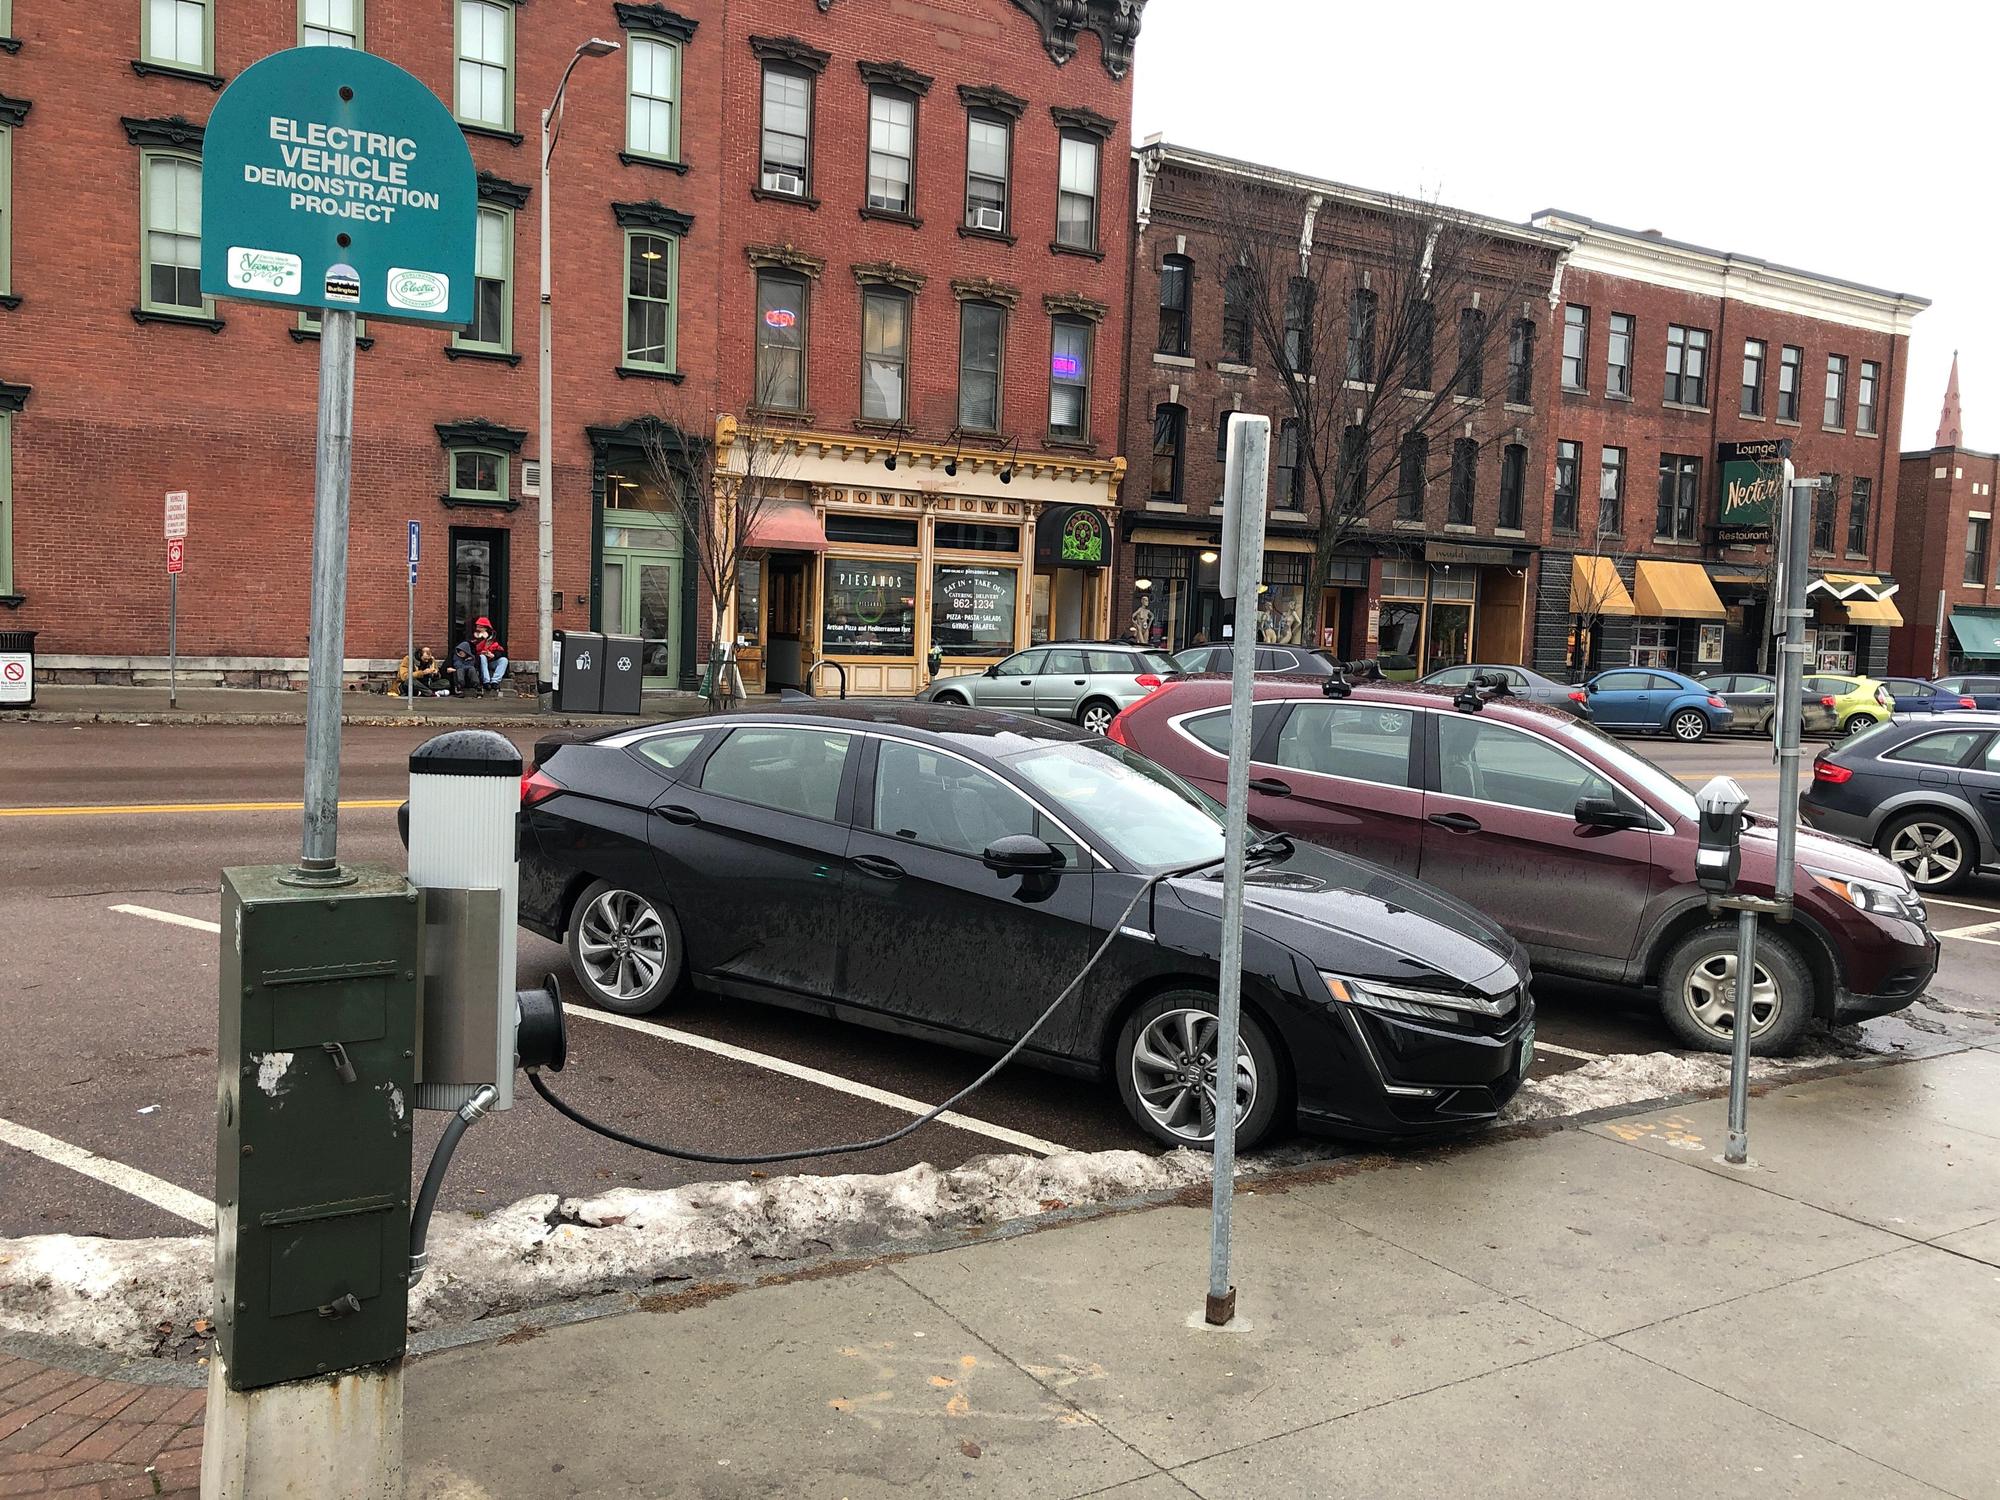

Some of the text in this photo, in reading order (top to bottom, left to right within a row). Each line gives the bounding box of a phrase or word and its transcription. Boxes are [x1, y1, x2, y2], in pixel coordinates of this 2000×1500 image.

[270, 116, 417, 161] ELECTRIC
[280, 144, 408, 186] VEHICLE
[244, 164, 439, 210] DEMONSTRATION
[290, 193, 395, 224] PROJECT
[327, 285, 358, 295] Burlington
[400, 280, 436, 294] Electric
[1736, 443, 1776, 457] Lounge
[1718, 530, 1770, 541] Restaurant
[840, 573, 902, 588] PIESANOS
[943, 578, 1007, 596] EAT IN TAKE OUT
[953, 598, 994, 609] 862-1234
[982, 614, 1002, 622] SALADS
[867, 625, 901, 633] Mediterranean
[951, 622, 970, 630] GYROS
